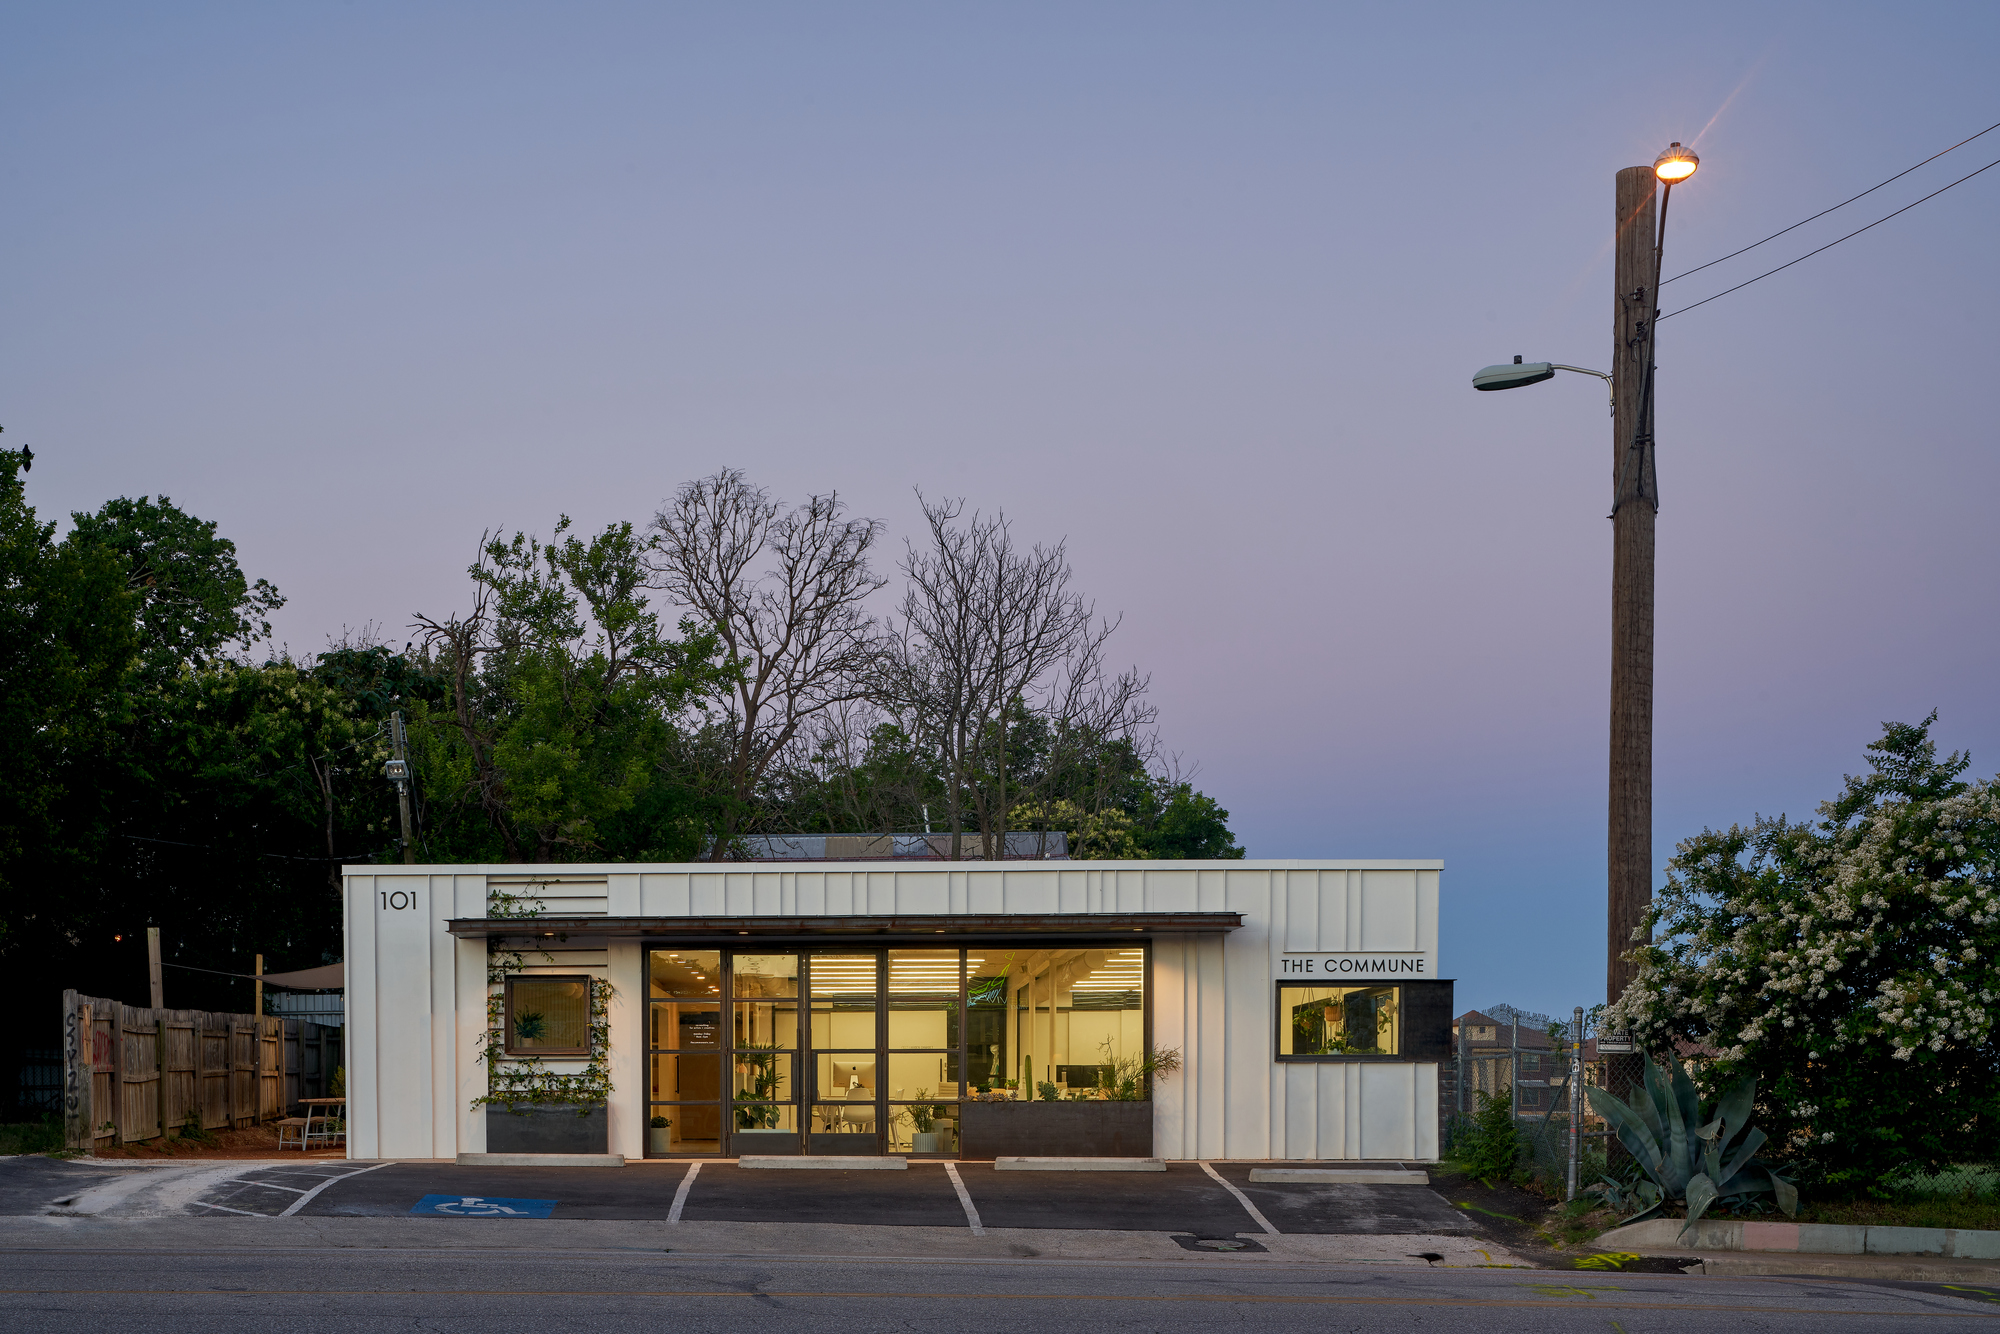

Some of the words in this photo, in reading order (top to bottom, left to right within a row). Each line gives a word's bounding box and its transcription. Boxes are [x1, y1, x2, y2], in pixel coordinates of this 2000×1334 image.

[381, 891, 417, 910] 101
[1281, 959, 1314, 972] THE
[1324, 958, 1424, 973] COMMUNE
